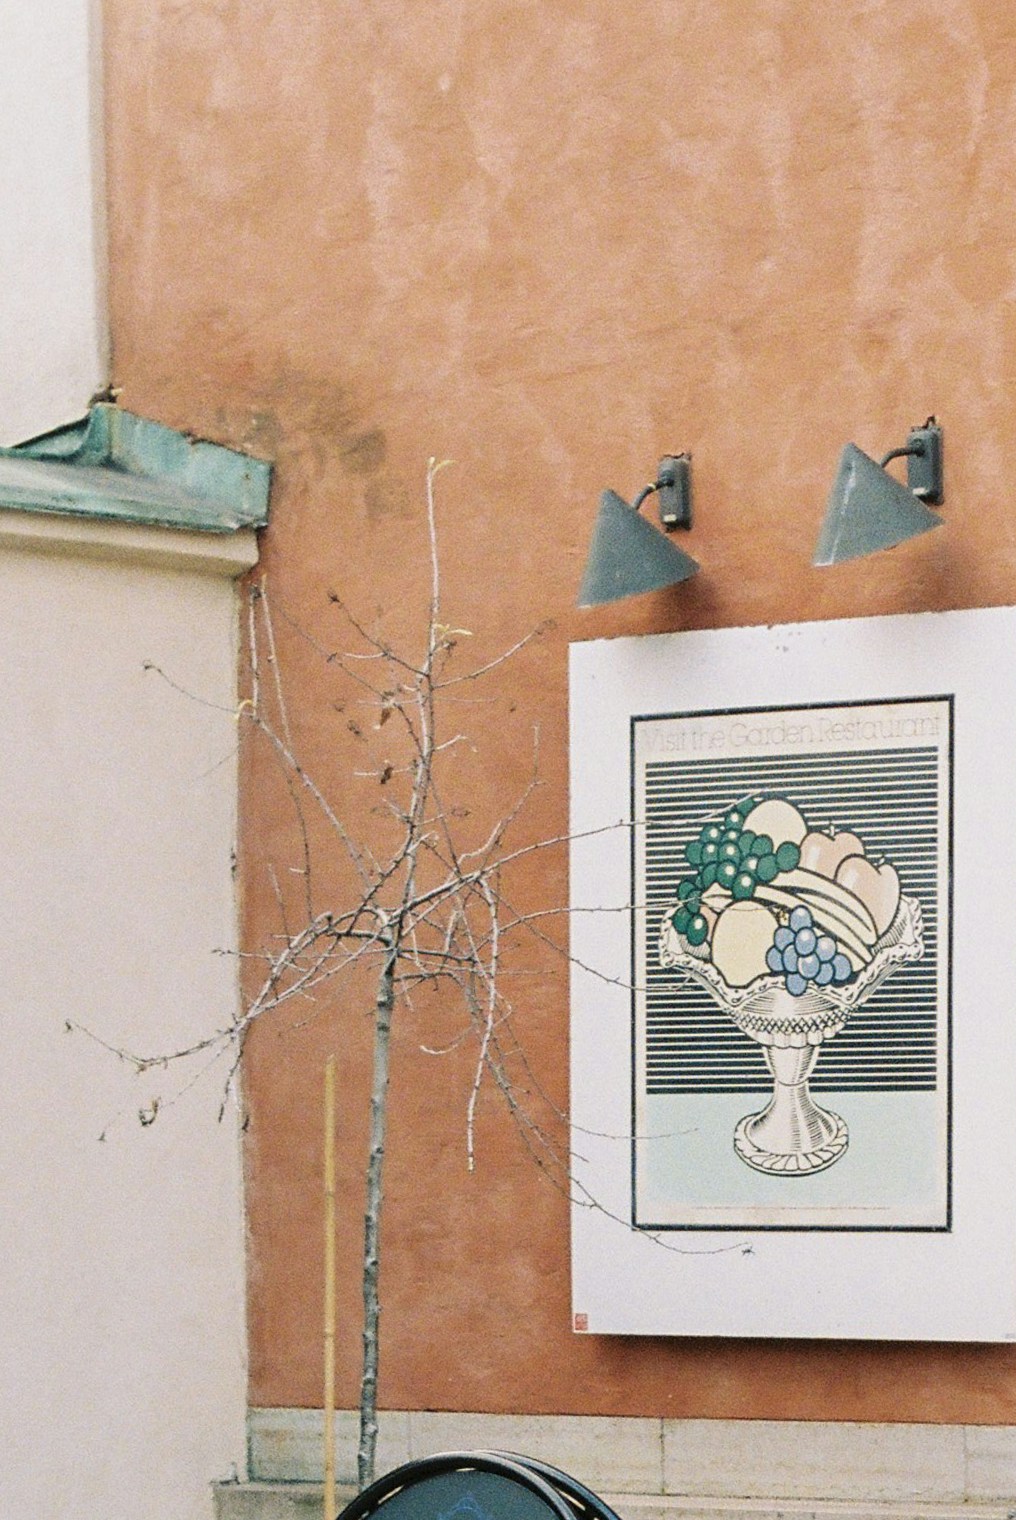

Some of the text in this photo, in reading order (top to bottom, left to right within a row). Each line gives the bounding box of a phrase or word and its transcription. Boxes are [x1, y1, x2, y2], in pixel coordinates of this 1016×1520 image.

[641, 714, 939, 752] Visit the Garden Restaurant
